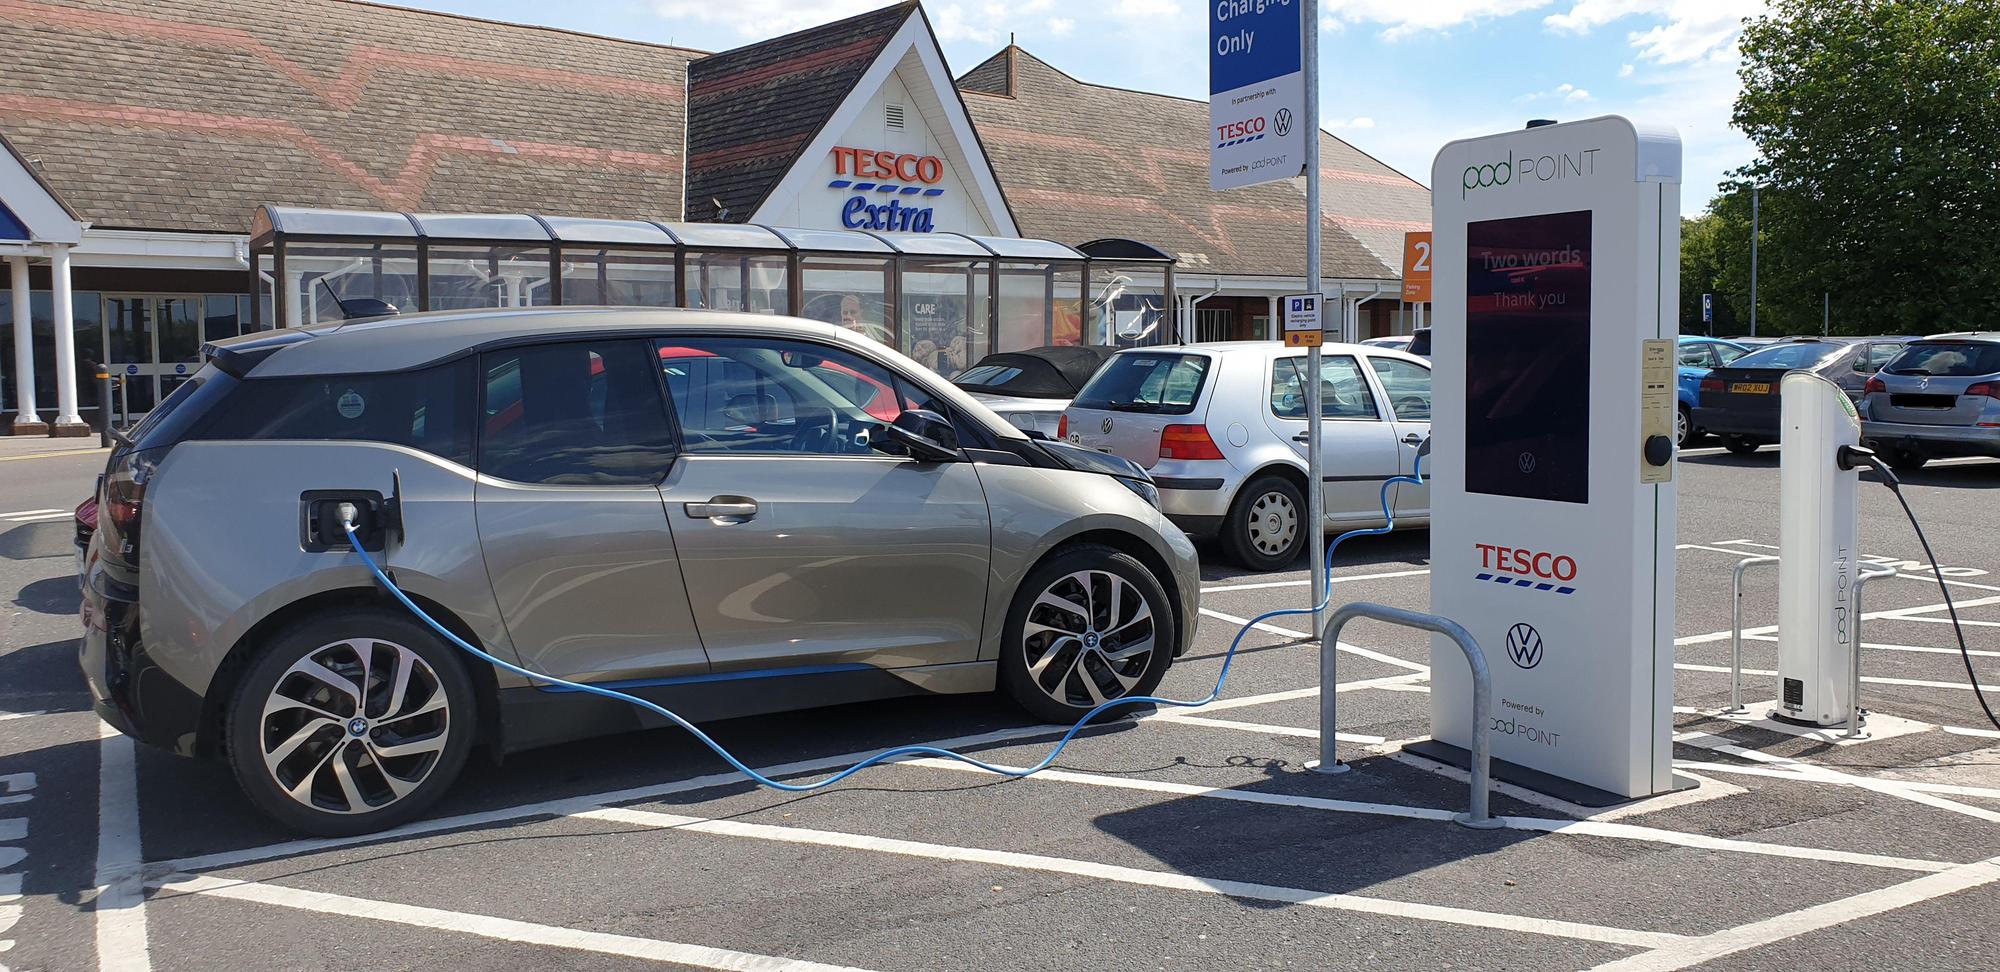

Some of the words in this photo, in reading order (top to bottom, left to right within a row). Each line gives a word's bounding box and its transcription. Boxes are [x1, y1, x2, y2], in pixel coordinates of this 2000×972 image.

[1217, 29, 1254, 56] Only
[1236, 91, 1266, 104] partnership
[1265, 88, 1277, 96] with
[1216, 116, 1266, 141] TESCO
[829, 145, 944, 184] TESCO
[1221, 165, 1242, 176] Powered
[1242, 164, 1249, 172] by
[1251, 156, 1266, 173] pod
[1266, 154, 1288, 168] POINT
[1462, 149, 1512, 201] pod
[1518, 148, 1601, 185] POINT
[841, 195, 935, 233] extra
[1412, 241, 1431, 272] 2
[1480, 250, 1518, 270] Two
[1522, 244, 1582, 268] words
[914, 303, 937, 315] CARE
[1493, 291, 1536, 309] Thank
[1538, 292, 1567, 310] you
[1475, 543, 1578, 582] TESCO
[1837, 544, 1848, 602] POINT
[1501, 698, 1534, 715] Powered
[1535, 708, 1545, 717] by
[1517, 724, 1561, 748] POINT
